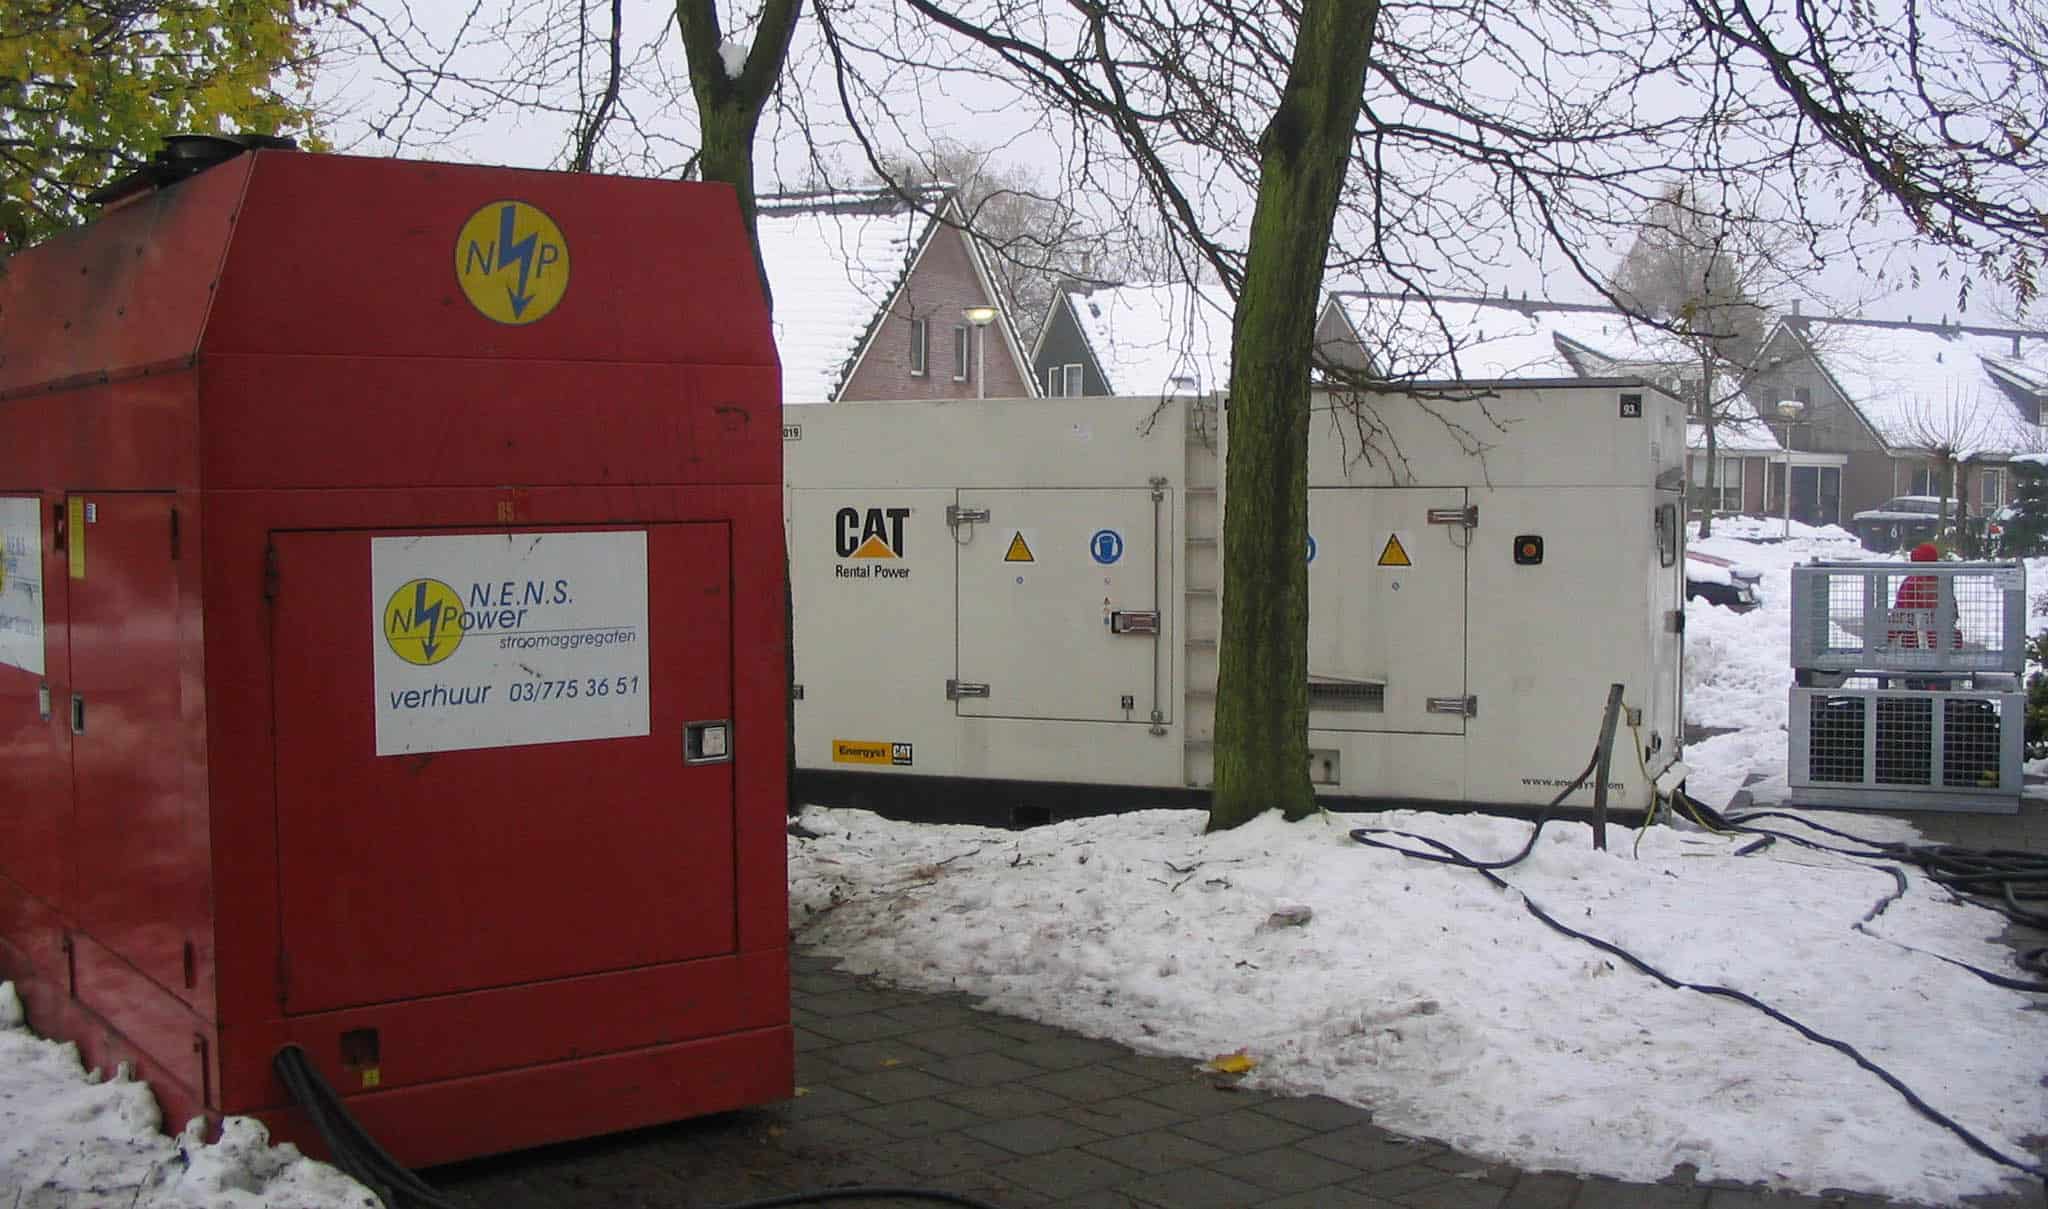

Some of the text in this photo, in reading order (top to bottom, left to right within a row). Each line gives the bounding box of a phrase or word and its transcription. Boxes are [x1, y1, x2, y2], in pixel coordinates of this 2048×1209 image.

[835, 507, 910, 559] CAT
[835, 564, 911, 579] Rental Power
[470, 579, 573, 607] N.E.N.S.
[441, 606, 528, 632] Power
[499, 630, 636, 650] stroomaggregaten
[390, 676, 640, 710] verhuur 03/775 36 51
